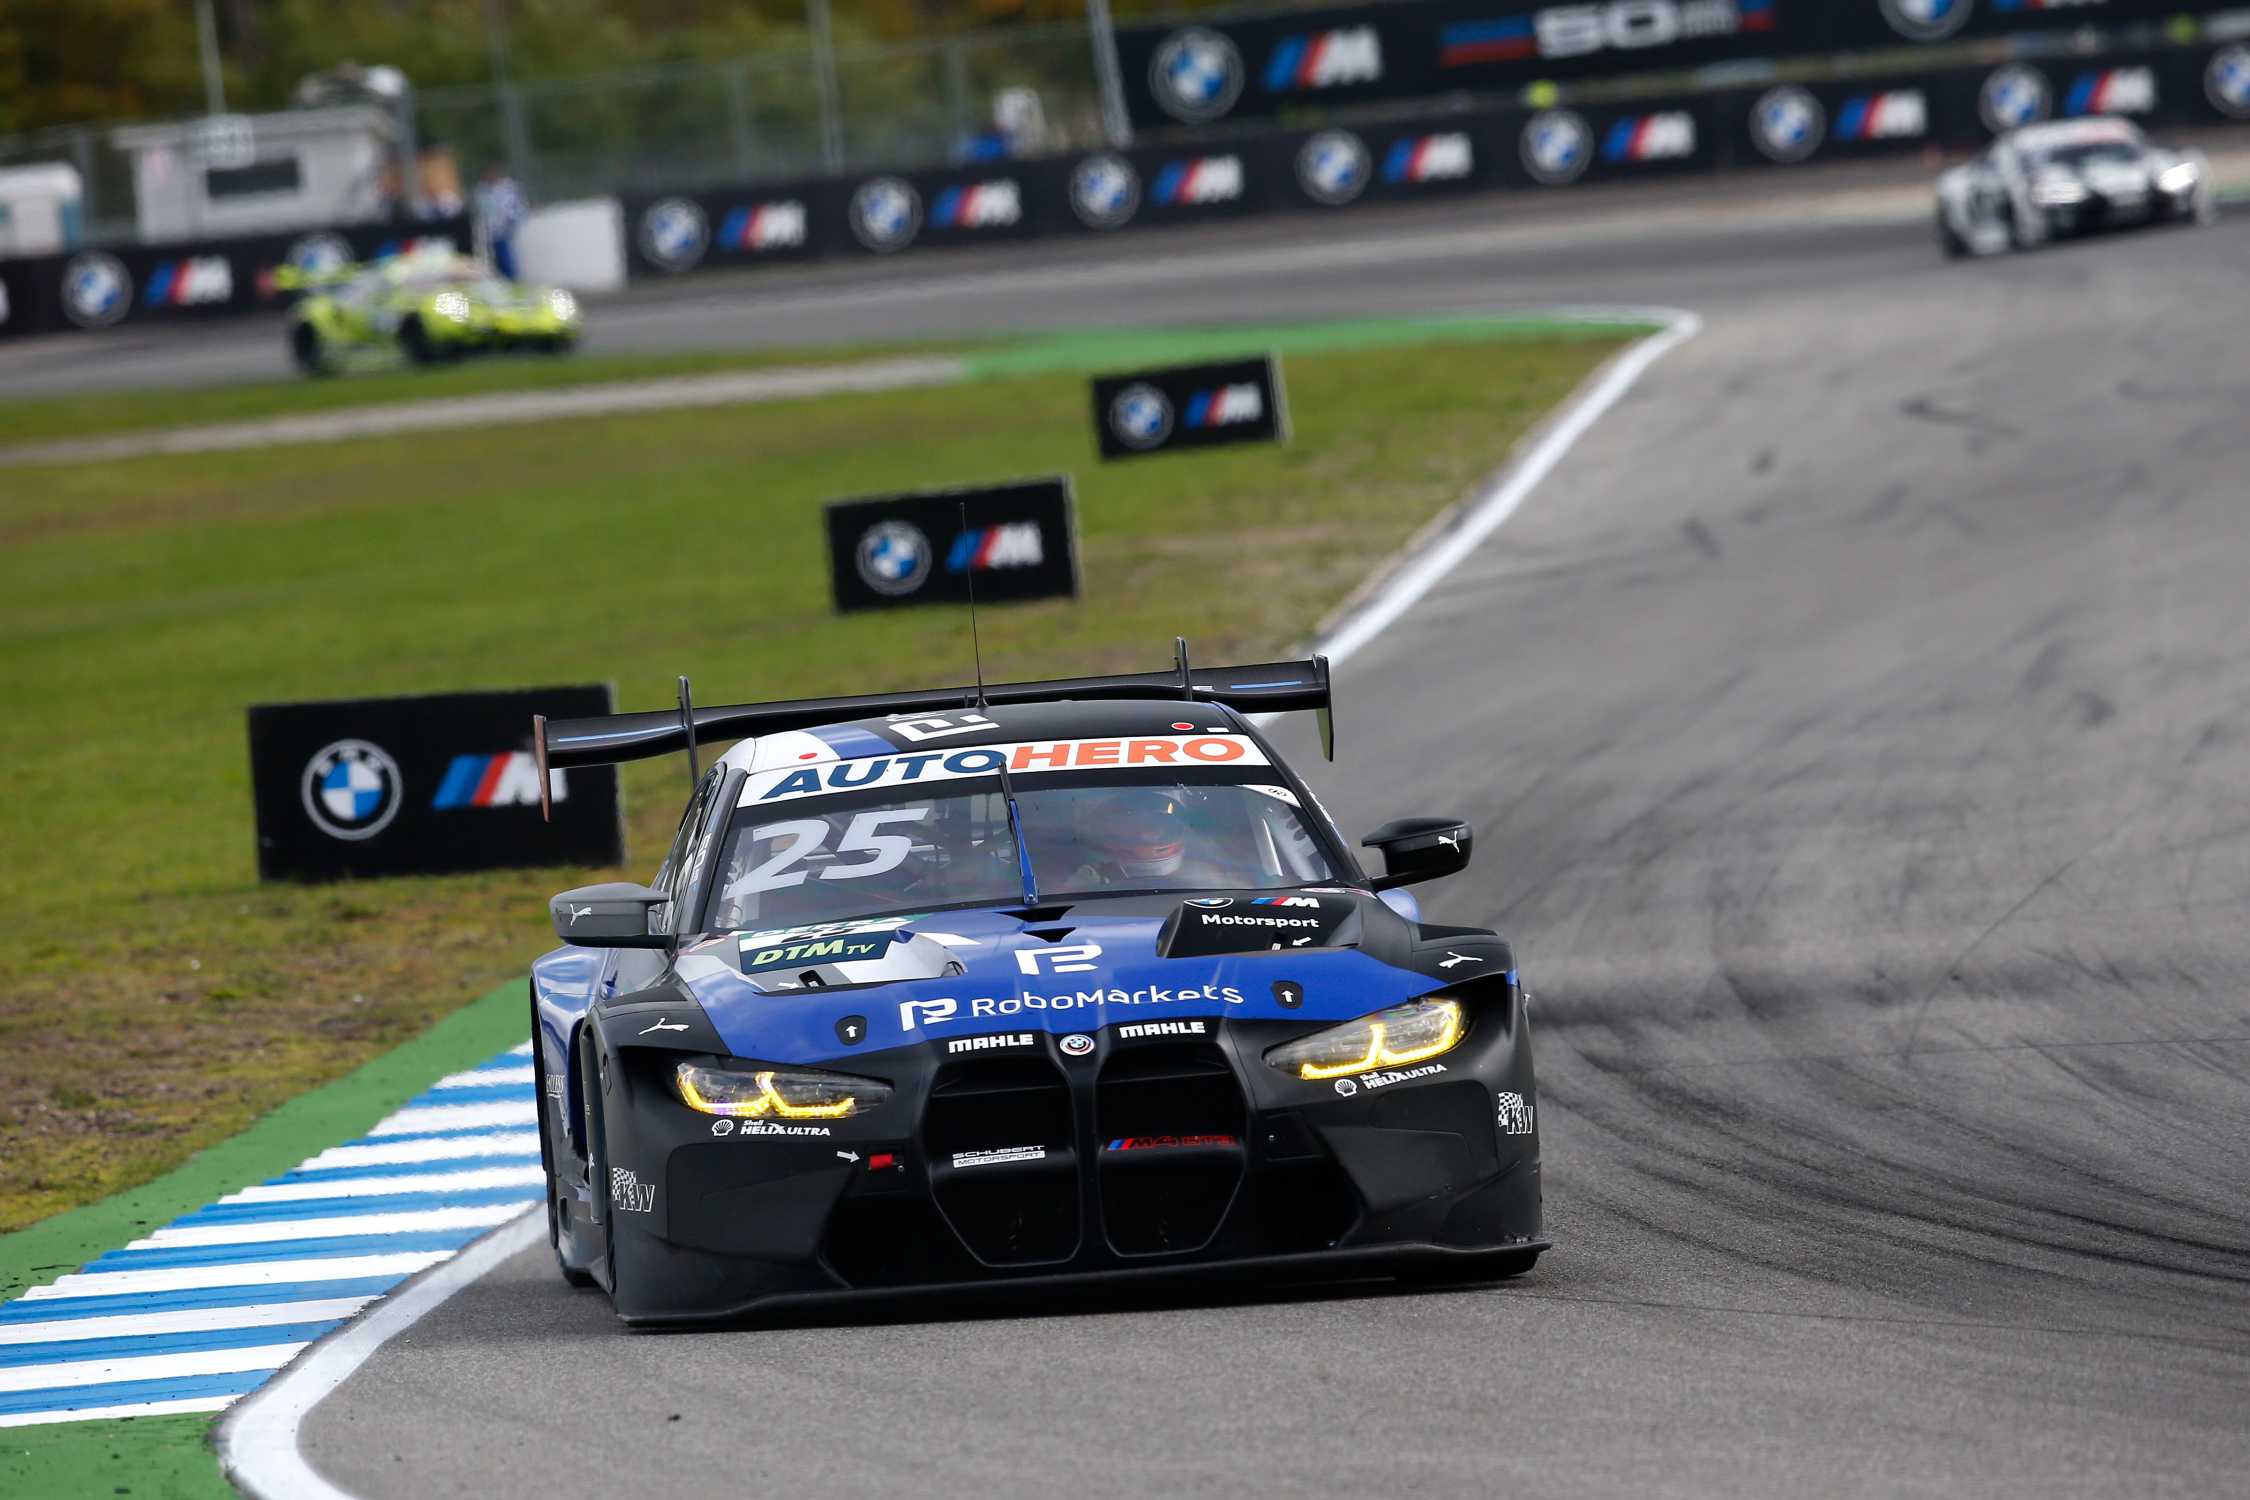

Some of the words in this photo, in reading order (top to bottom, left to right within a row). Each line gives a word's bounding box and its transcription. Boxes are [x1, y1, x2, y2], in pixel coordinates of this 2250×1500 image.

[724, 808, 929, 899] 25
[1201, 914, 1320, 928] Motorsport
[751, 939, 844, 966] DTM
[846, 943, 876, 956] TV
[971, 985, 1244, 1017] RoboMarkets
[1119, 1021, 1206, 1039] MAHLE
[949, 1034, 1034, 1054] MAHLE
[1404, 1063, 1447, 1080] ULTRA
[1506, 1105, 1533, 1134] KW
[787, 1127, 831, 1136] ULTRA
[952, 1145, 1045, 1159] SCHUBERT
[619, 1182, 656, 1213] KW
